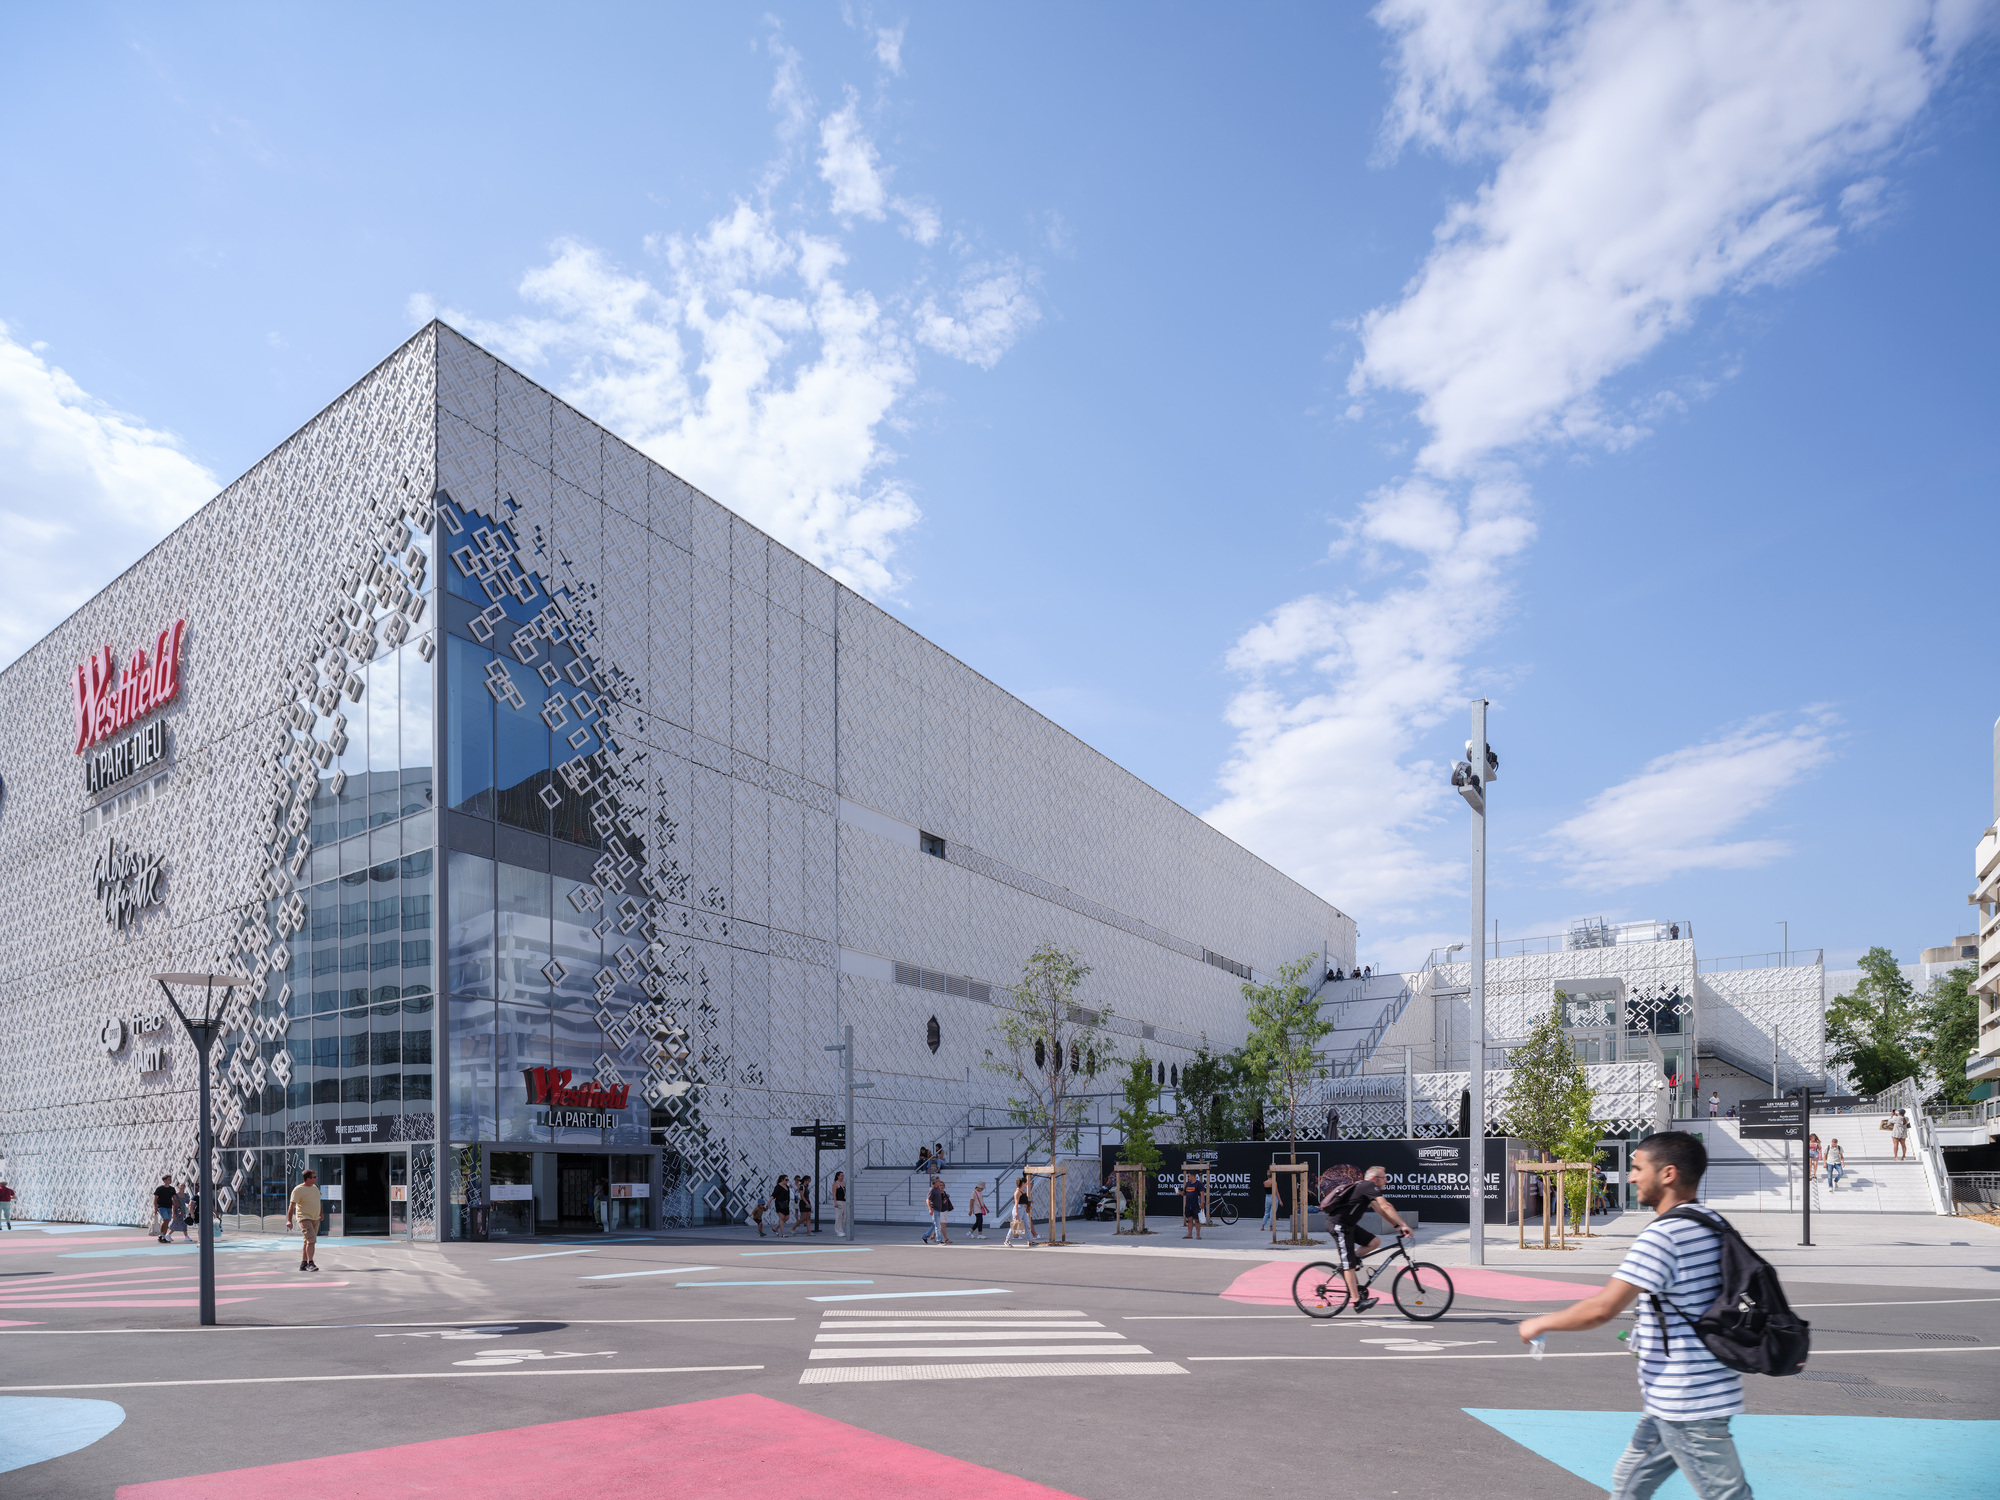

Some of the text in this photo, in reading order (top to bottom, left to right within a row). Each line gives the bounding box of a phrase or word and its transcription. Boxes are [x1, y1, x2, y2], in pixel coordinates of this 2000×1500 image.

[70, 618, 185, 755] Westfield
[85, 719, 165, 794] LA PART-DIEU
[131, 1012, 164, 1036] fnac
[131, 1047, 164, 1074] DARTY
[527, 1066, 632, 1109] Westfield
[1323, 1082, 1397, 1099] HIPPOPOTAMUS
[548, 1111, 619, 1129] LA PART-DIEU
[1418, 1149, 1459, 1158] HIPPOPOTAMUS
[1158, 1173, 1251, 1183] ON CARBONNE
[1386, 1173, 1500, 1184] ON CHARBONE
[1453, 1182, 1459, 1191] À
